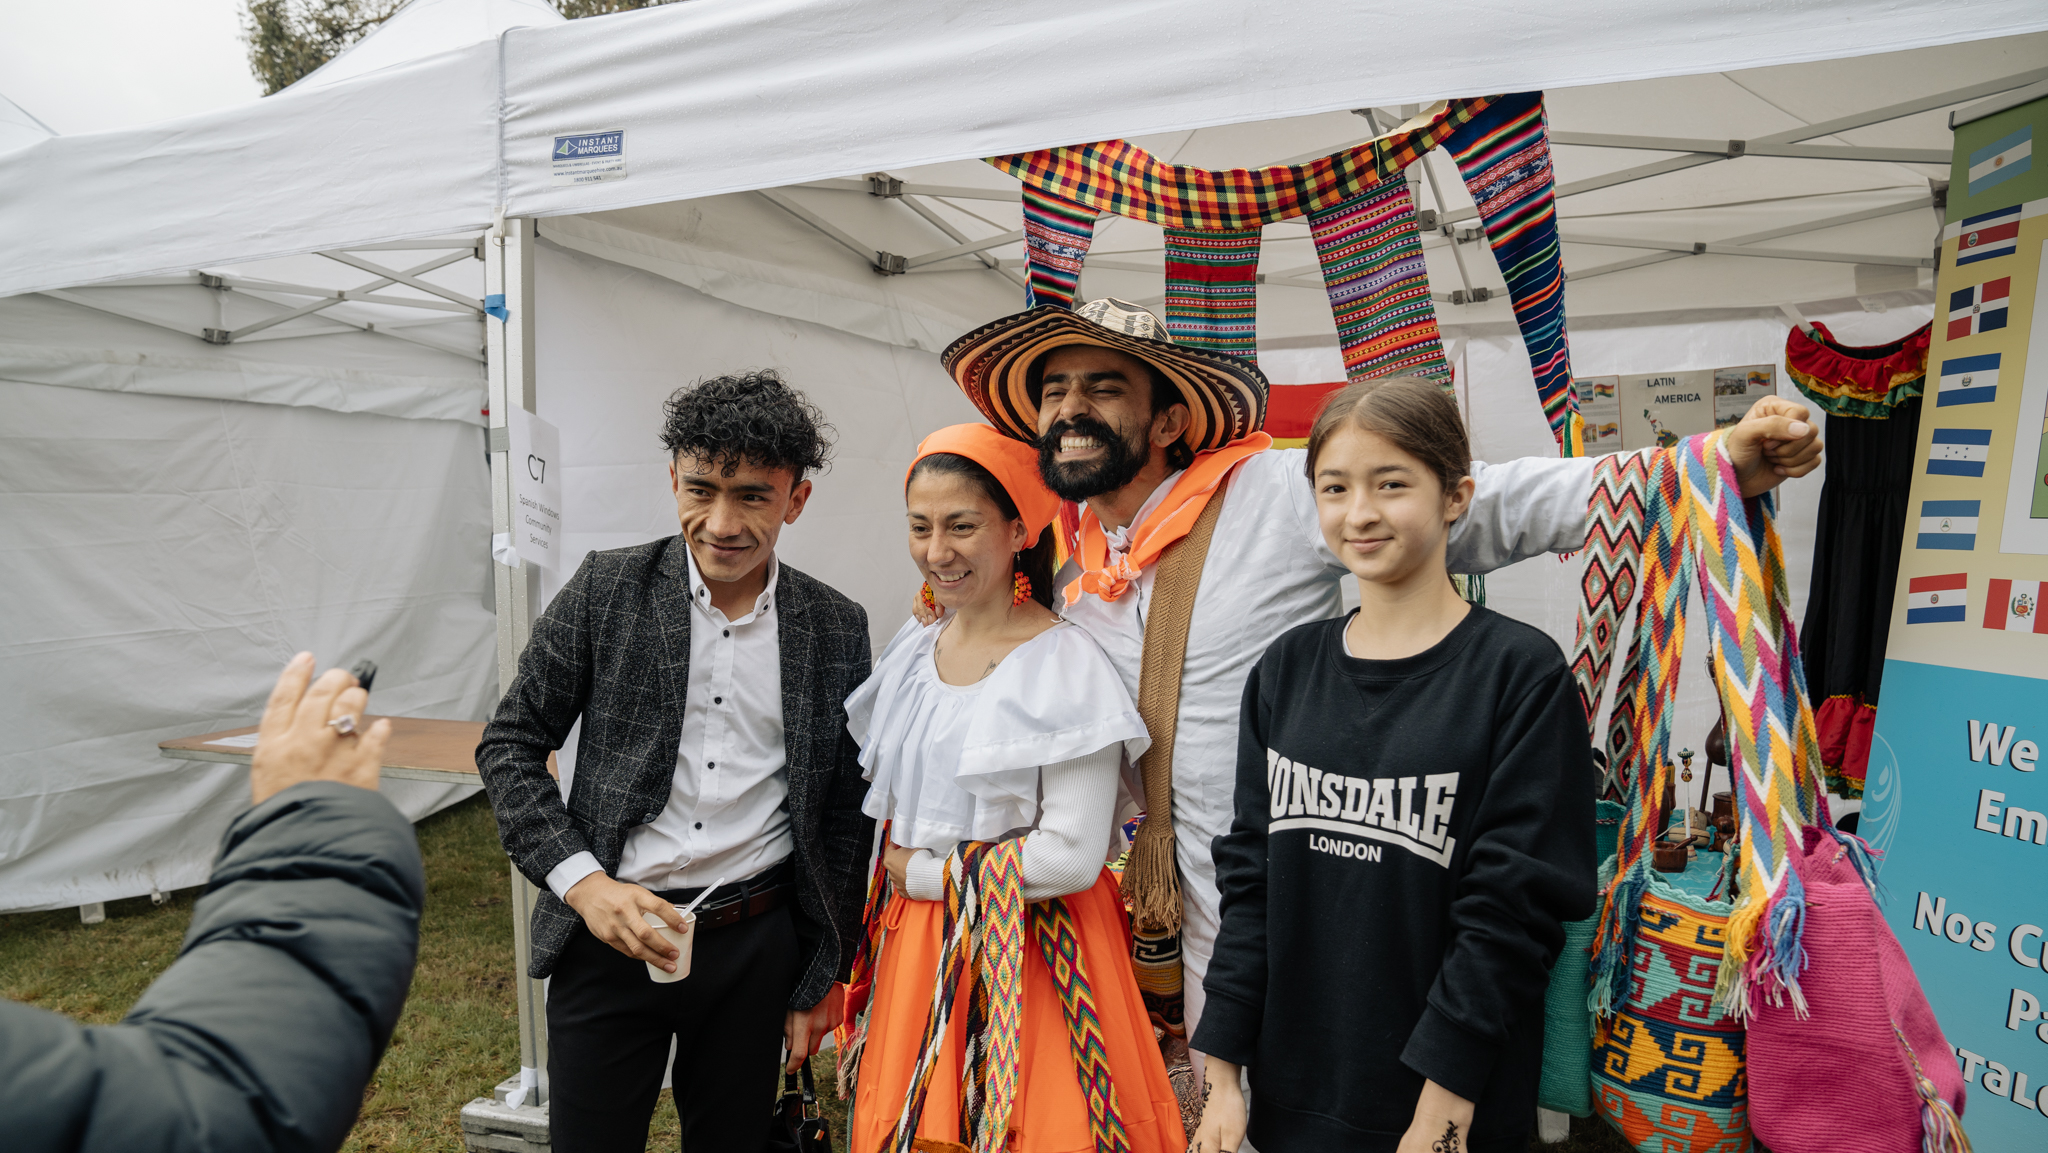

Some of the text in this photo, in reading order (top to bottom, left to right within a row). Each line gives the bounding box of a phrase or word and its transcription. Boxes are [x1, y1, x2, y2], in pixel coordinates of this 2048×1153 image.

[577, 144, 618, 155] MARQUEES
[578, 136, 619, 146] INSTANT
[1647, 377, 1675, 388] LATIN
[1654, 393, 1701, 404] AMERICA
[528, 454, 546, 484] C7
[519, 493, 560, 520] Spanish Windows
[525, 514, 552, 535] Community
[530, 533, 549, 549] Services
[1967, 719, 2039, 772] We
[1309, 834, 1382, 863] LONDON
[1913, 891, 2048, 974] Nos C
